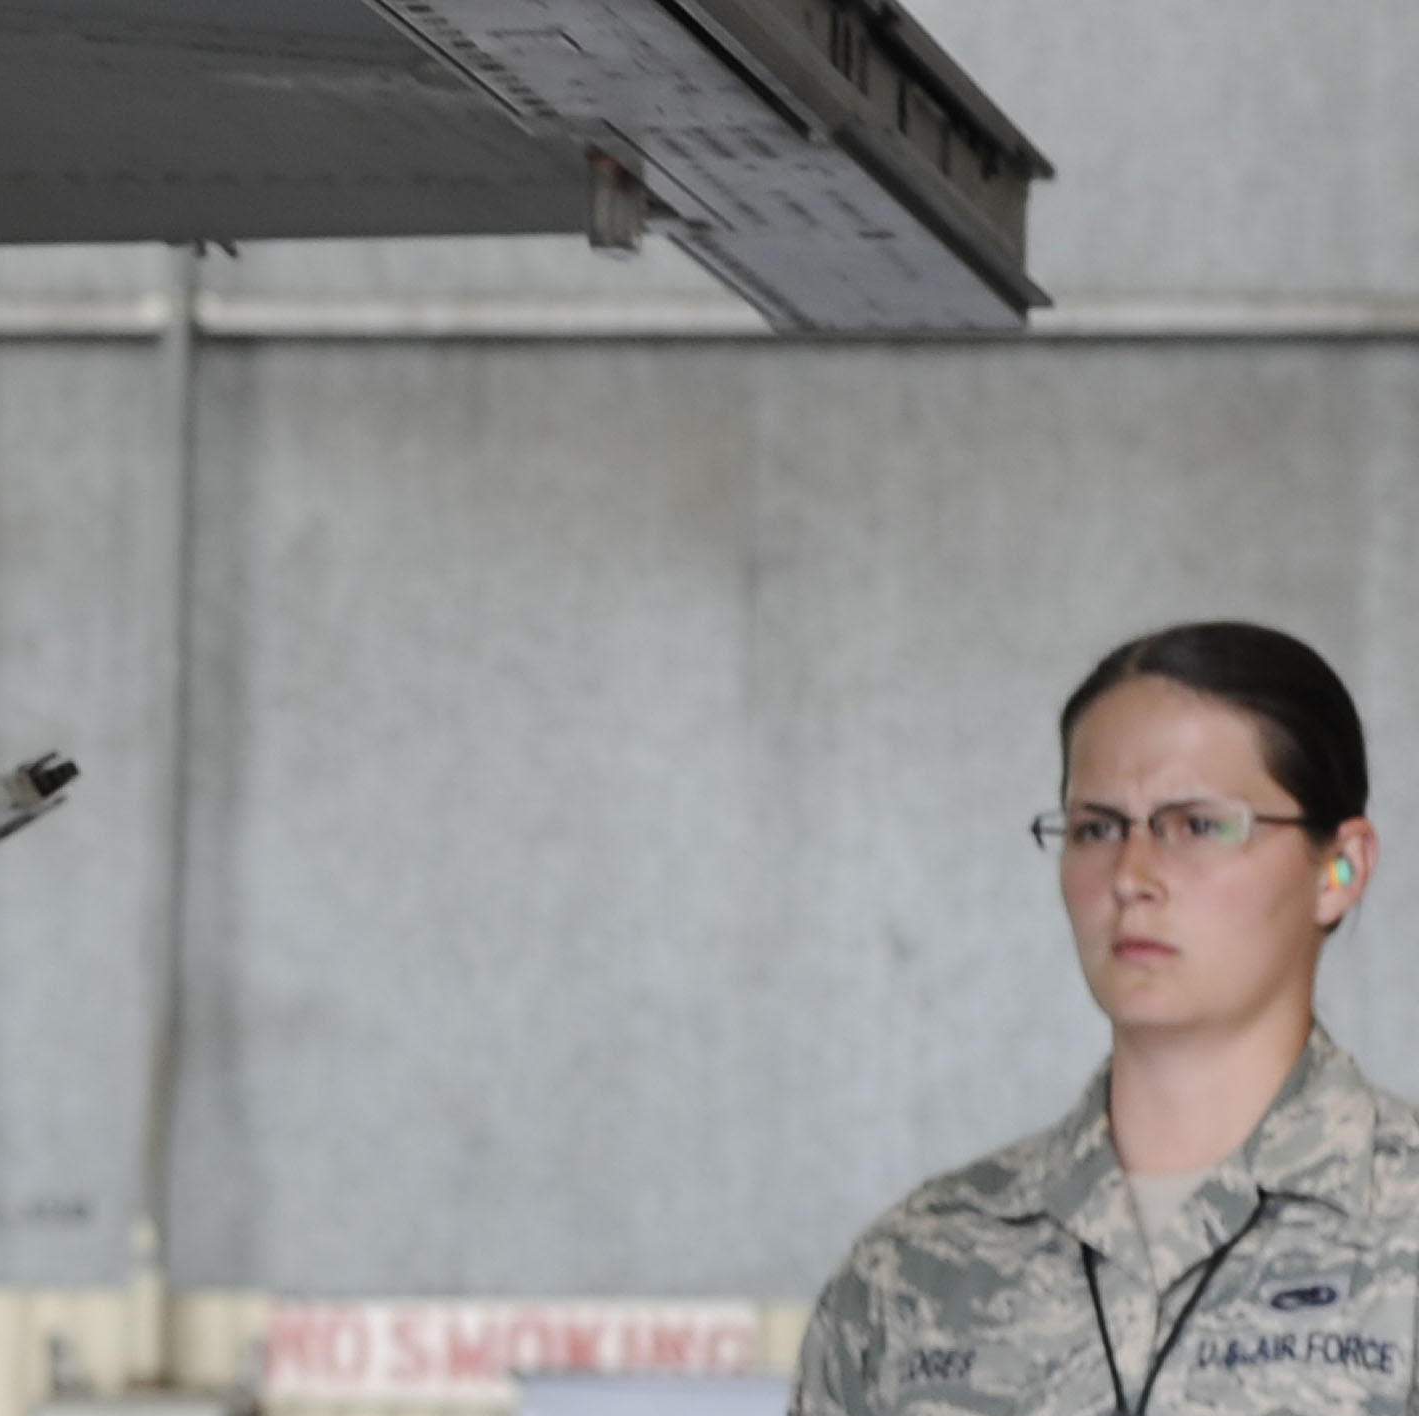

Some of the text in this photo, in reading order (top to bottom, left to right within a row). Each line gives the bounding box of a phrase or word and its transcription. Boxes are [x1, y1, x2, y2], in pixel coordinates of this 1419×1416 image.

[267, 1307, 755, 1382] NO SMOKING
[1251, 1333, 1297, 1363] AIR
[1307, 1328, 1397, 1375] FORCE
